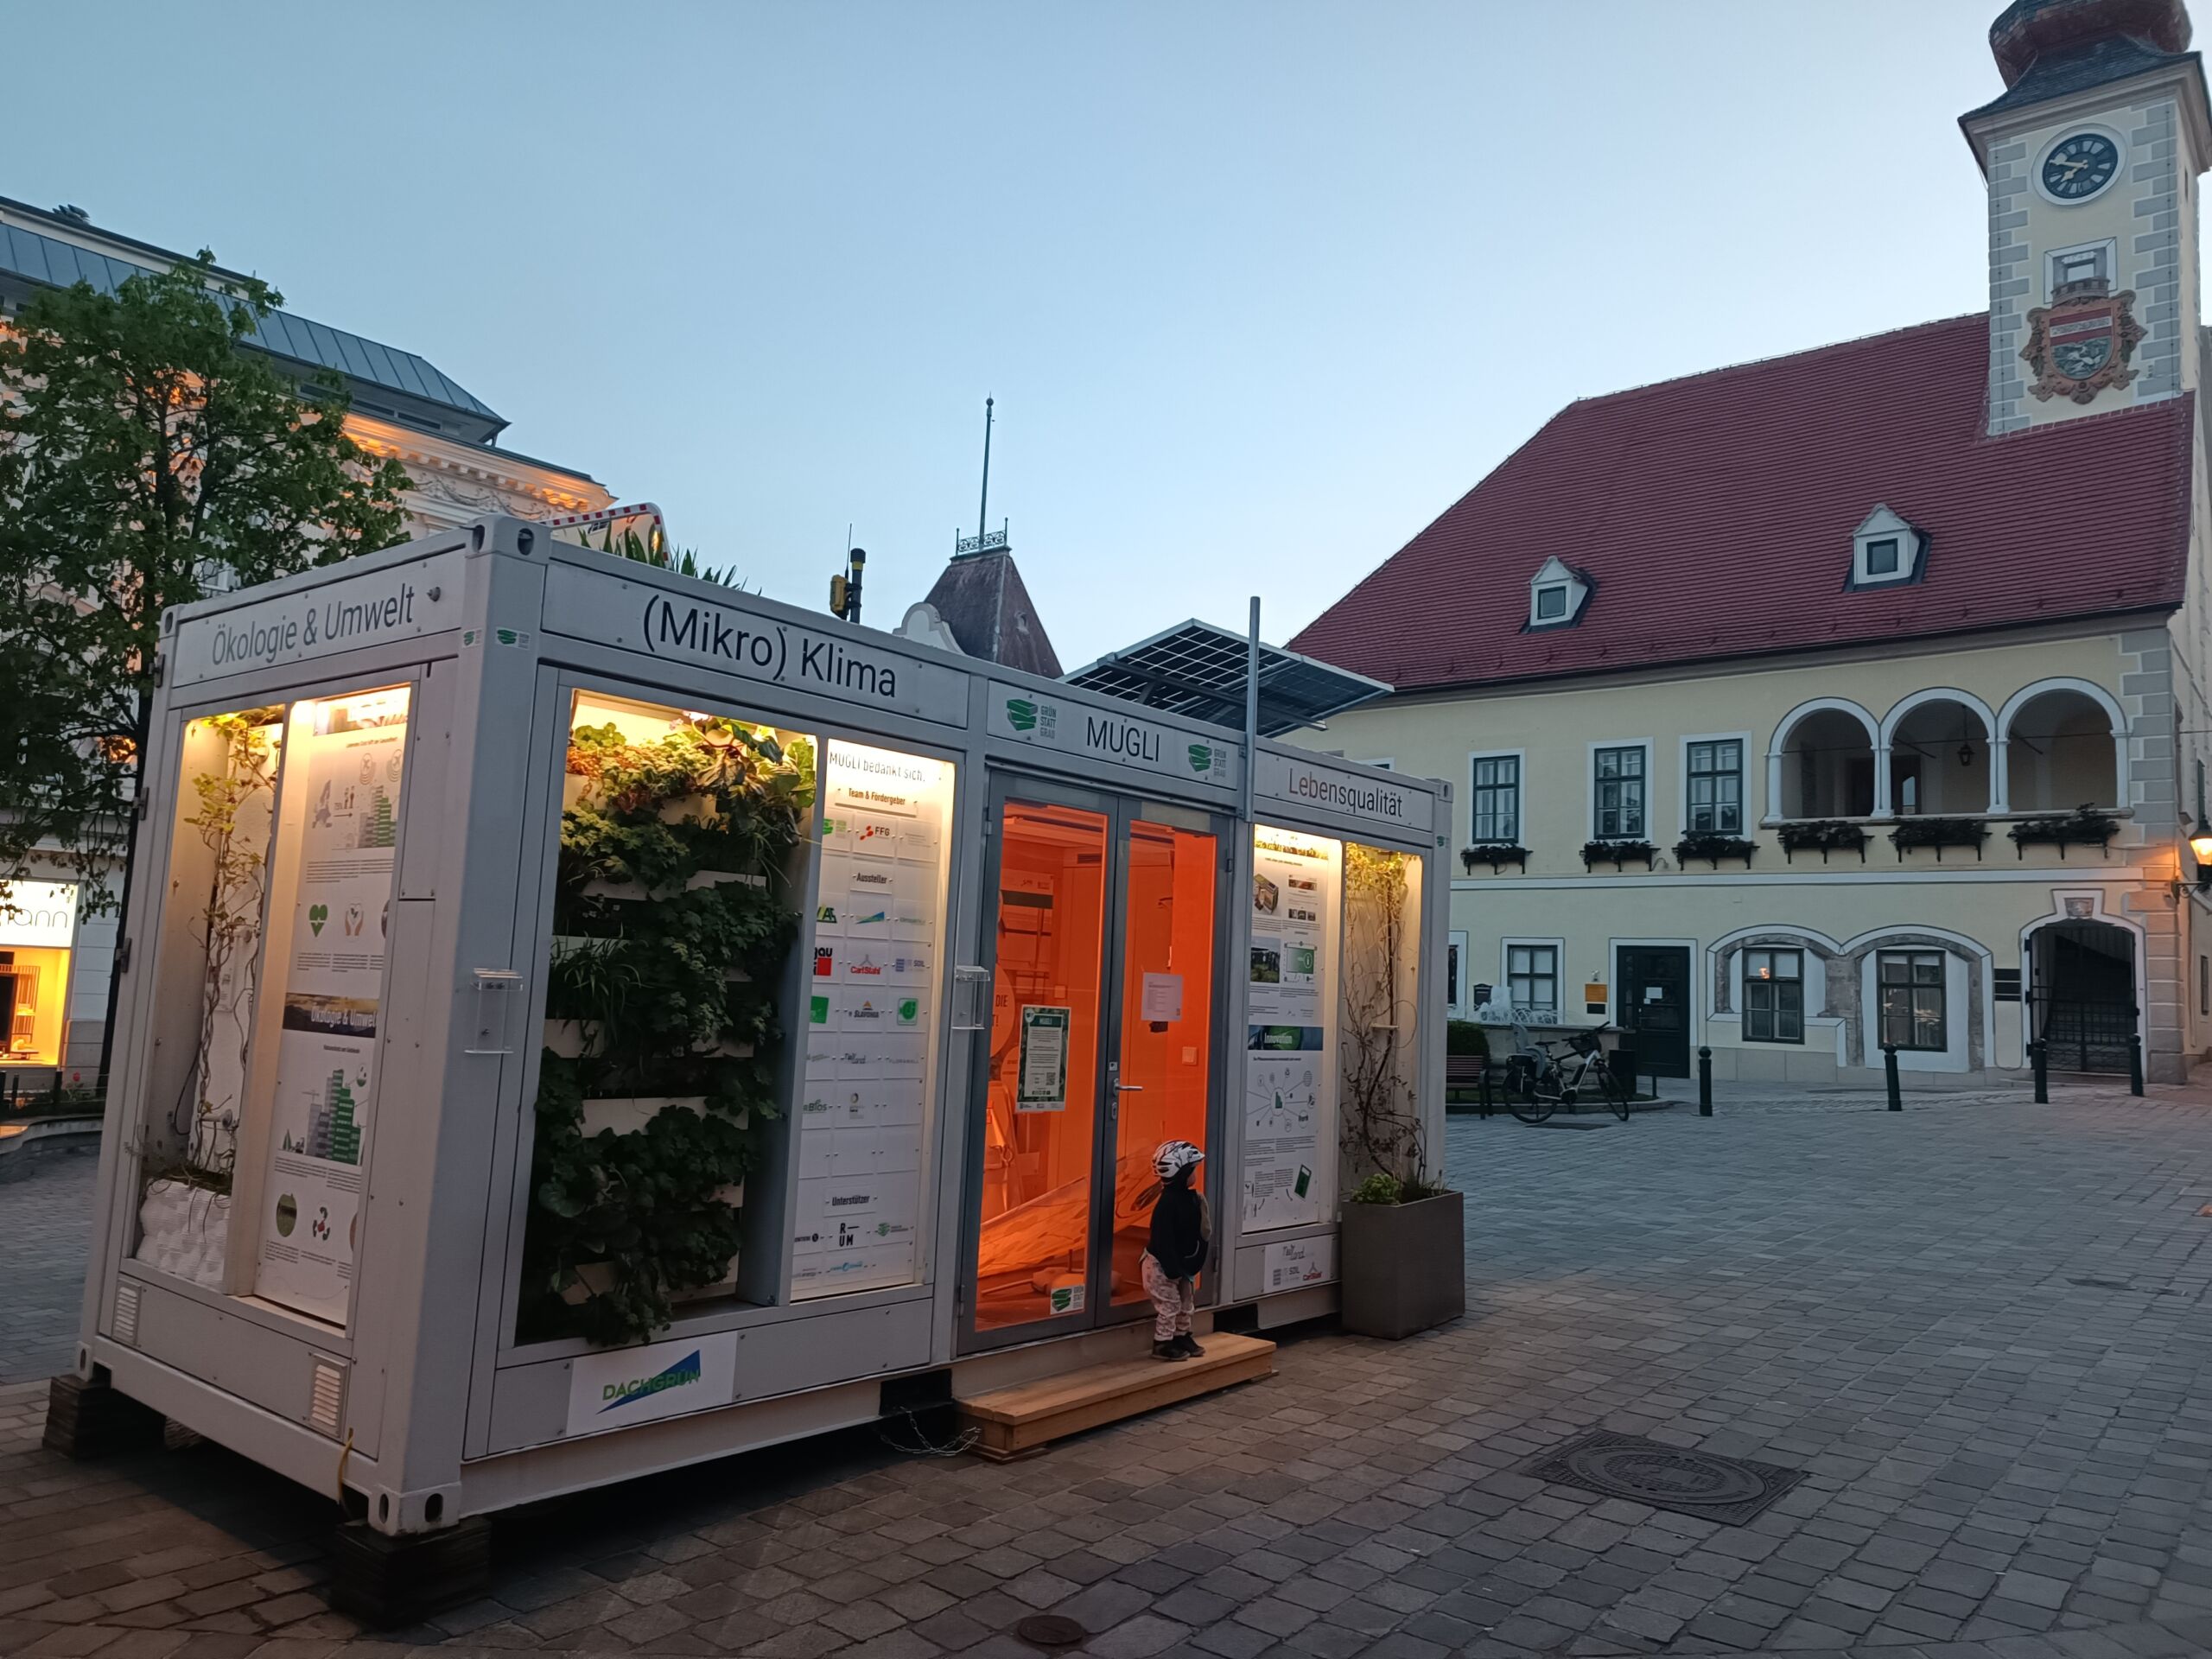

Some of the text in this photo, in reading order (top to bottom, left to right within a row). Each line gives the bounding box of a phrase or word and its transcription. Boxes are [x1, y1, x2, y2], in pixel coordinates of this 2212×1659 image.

[212, 583, 415, 666] Ökologie & Umwelt
[643, 594, 897, 698] (Mikro) Klima
[1039, 704, 1057, 718] GRÜN
[1039, 716, 1057, 729] STATT
[1086, 716, 1160, 762] MUGLI
[829, 751, 861, 770] MUGLI
[863, 759, 901, 777] bedankt
[849, 788, 906, 806] Team & Fördergeber
[1288, 767, 1403, 818] Lebensqualität
[874, 826, 890, 836] FFG
[856, 872, 888, 884] Aussteller
[995, 994, 1008, 1007] DIE
[349, 1009, 377, 1028] Umwel
[832, 1195, 870, 1206] Unterstützer
[839, 1235, 854, 1247] UM
[601, 1369, 701, 1401] DACHGRÜN
